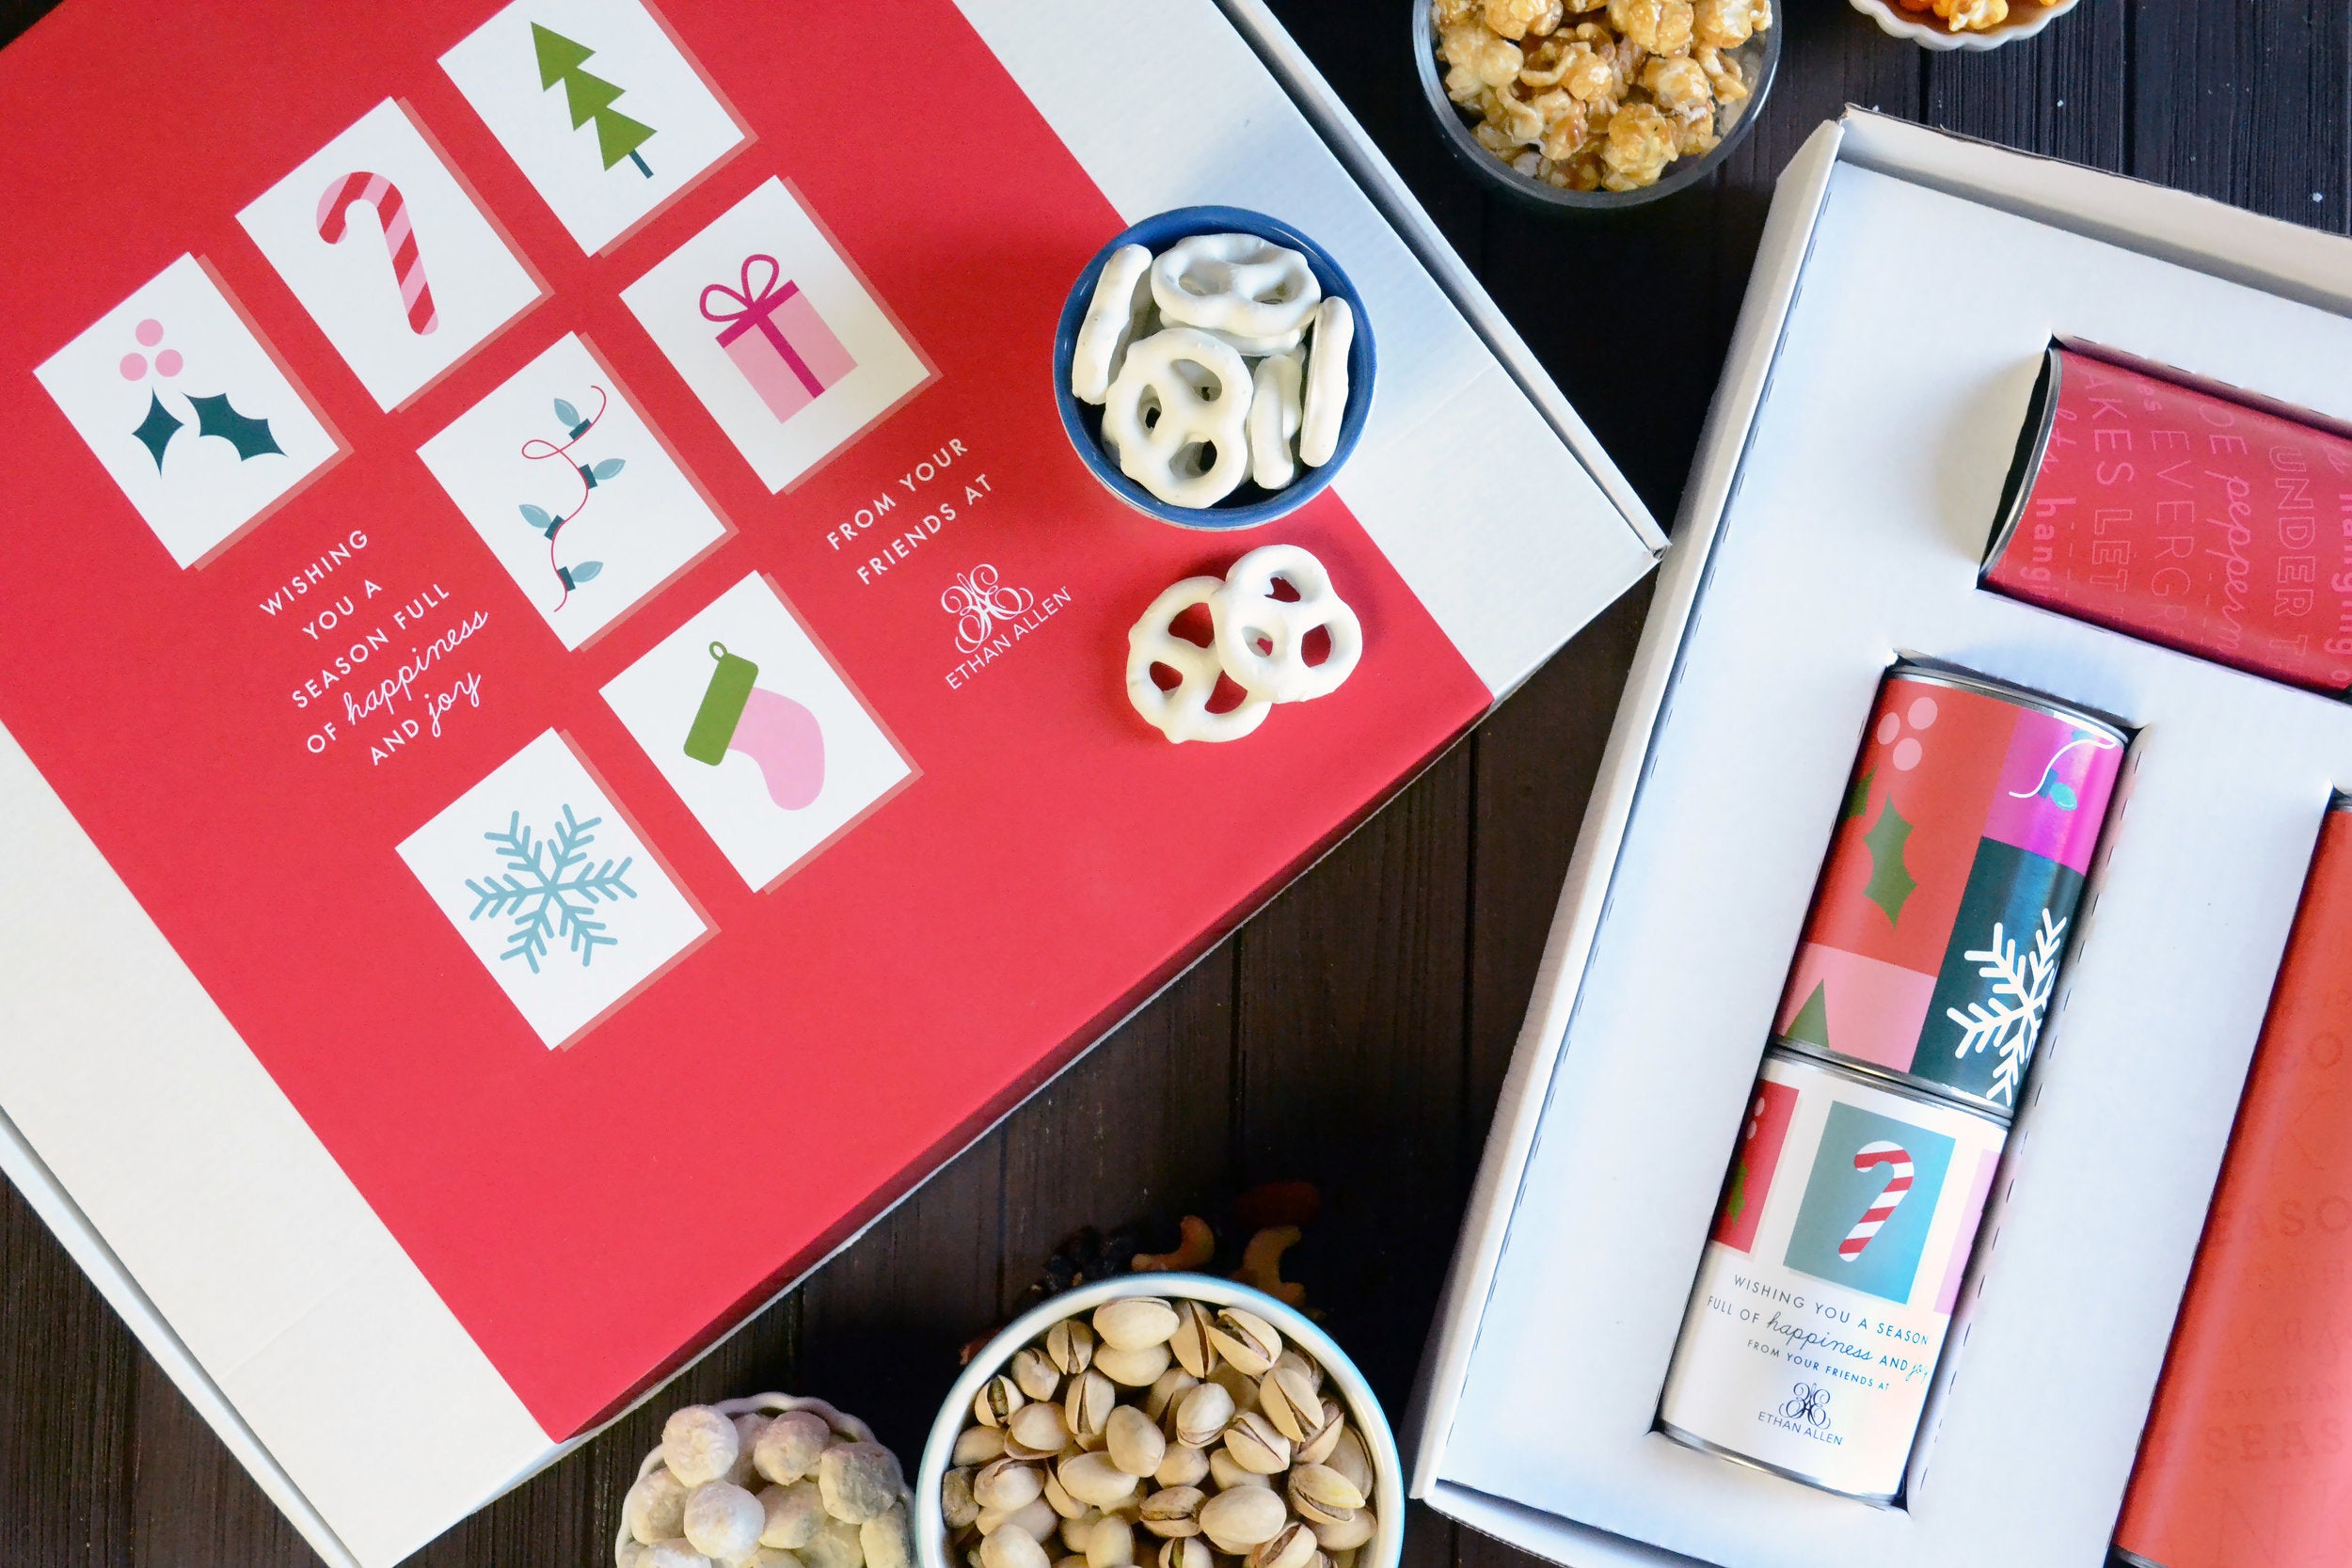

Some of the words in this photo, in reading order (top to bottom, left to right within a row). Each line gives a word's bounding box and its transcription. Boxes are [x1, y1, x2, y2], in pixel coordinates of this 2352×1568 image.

[826, 493, 896, 550] FROM
[898, 438, 968, 492] YOUR
[856, 502, 956, 585] FRIENDS
[964, 473, 992, 505] AT
[2269, 445, 2316, 618] UNDER
[260, 531, 368, 616] WISHING
[2090, 508, 2133, 593] LET
[293, 627, 389, 708] SEASON
[392, 583, 449, 630] FULL
[302, 596, 354, 640] YOU
[365, 579, 382, 599] A
[945, 634, 1011, 689] ETHAN
[1013, 587, 1072, 641] ALLEN
[307, 721, 337, 753] OF
[343, 610, 488, 725] happiness
[371, 719, 420, 766] AND
[424, 673, 481, 737] joy
[1708, 1295, 1732, 1315] FULL
[1740, 1308, 1760, 1323] OF
[1767, 1311, 1873, 1360] happiness
[1880, 1355, 1908, 1370] AND
[1734, 1275, 1804, 1308] WISHING
[1815, 1302, 1851, 1323] YOU
[1858, 1318, 1868, 1329] A
[1877, 1323, 1929, 1345] SEASON
[1747, 1339, 1780, 1357] FROM
[1787, 1353, 1820, 1370] YOUR
[1826, 1366, 1873, 1387] FRIENDS
[1879, 1382, 1889, 1390] AT
[1758, 1411, 1802, 1433] ETHAN
[1804, 1427, 1843, 1446] ALLEN
